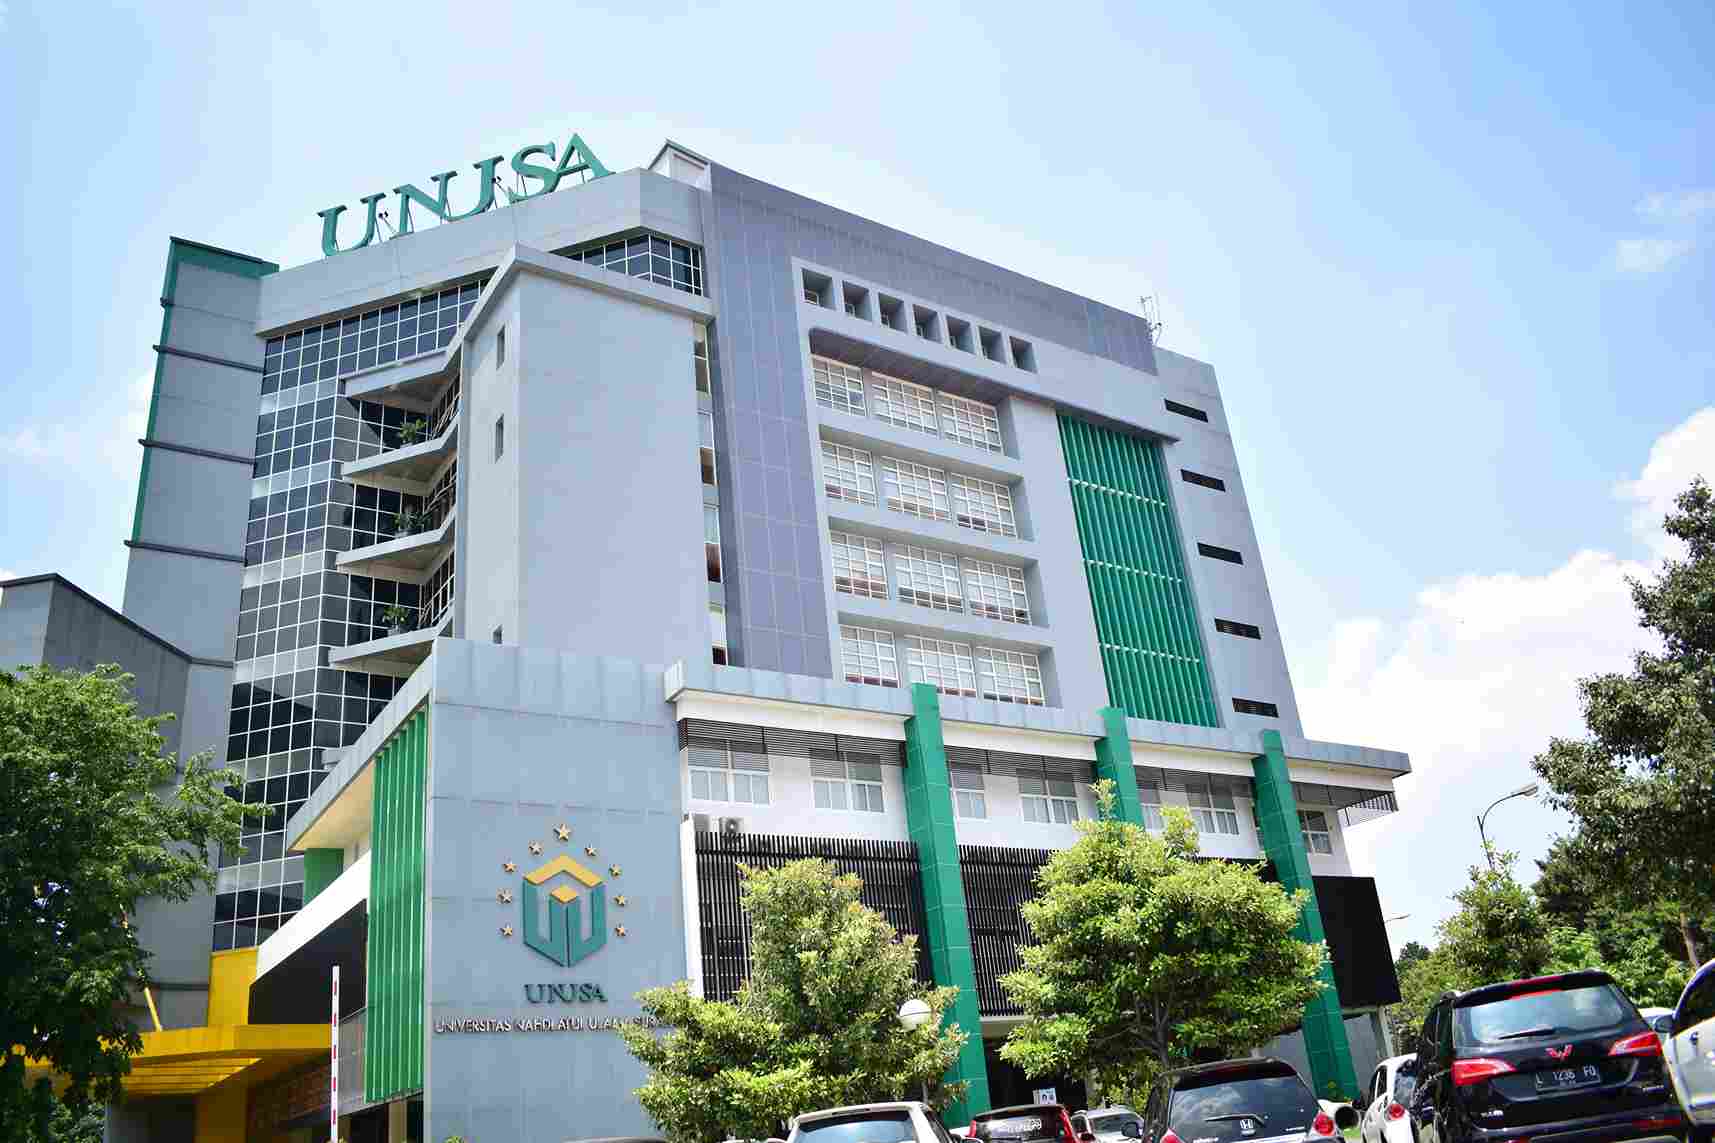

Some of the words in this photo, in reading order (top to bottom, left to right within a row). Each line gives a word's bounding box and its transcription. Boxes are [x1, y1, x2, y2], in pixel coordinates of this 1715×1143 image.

[316, 133, 617, 257] UNUSA
[524, 983, 608, 1004] UNUSA
[433, 1015, 512, 1033] UNIVERSITAS
